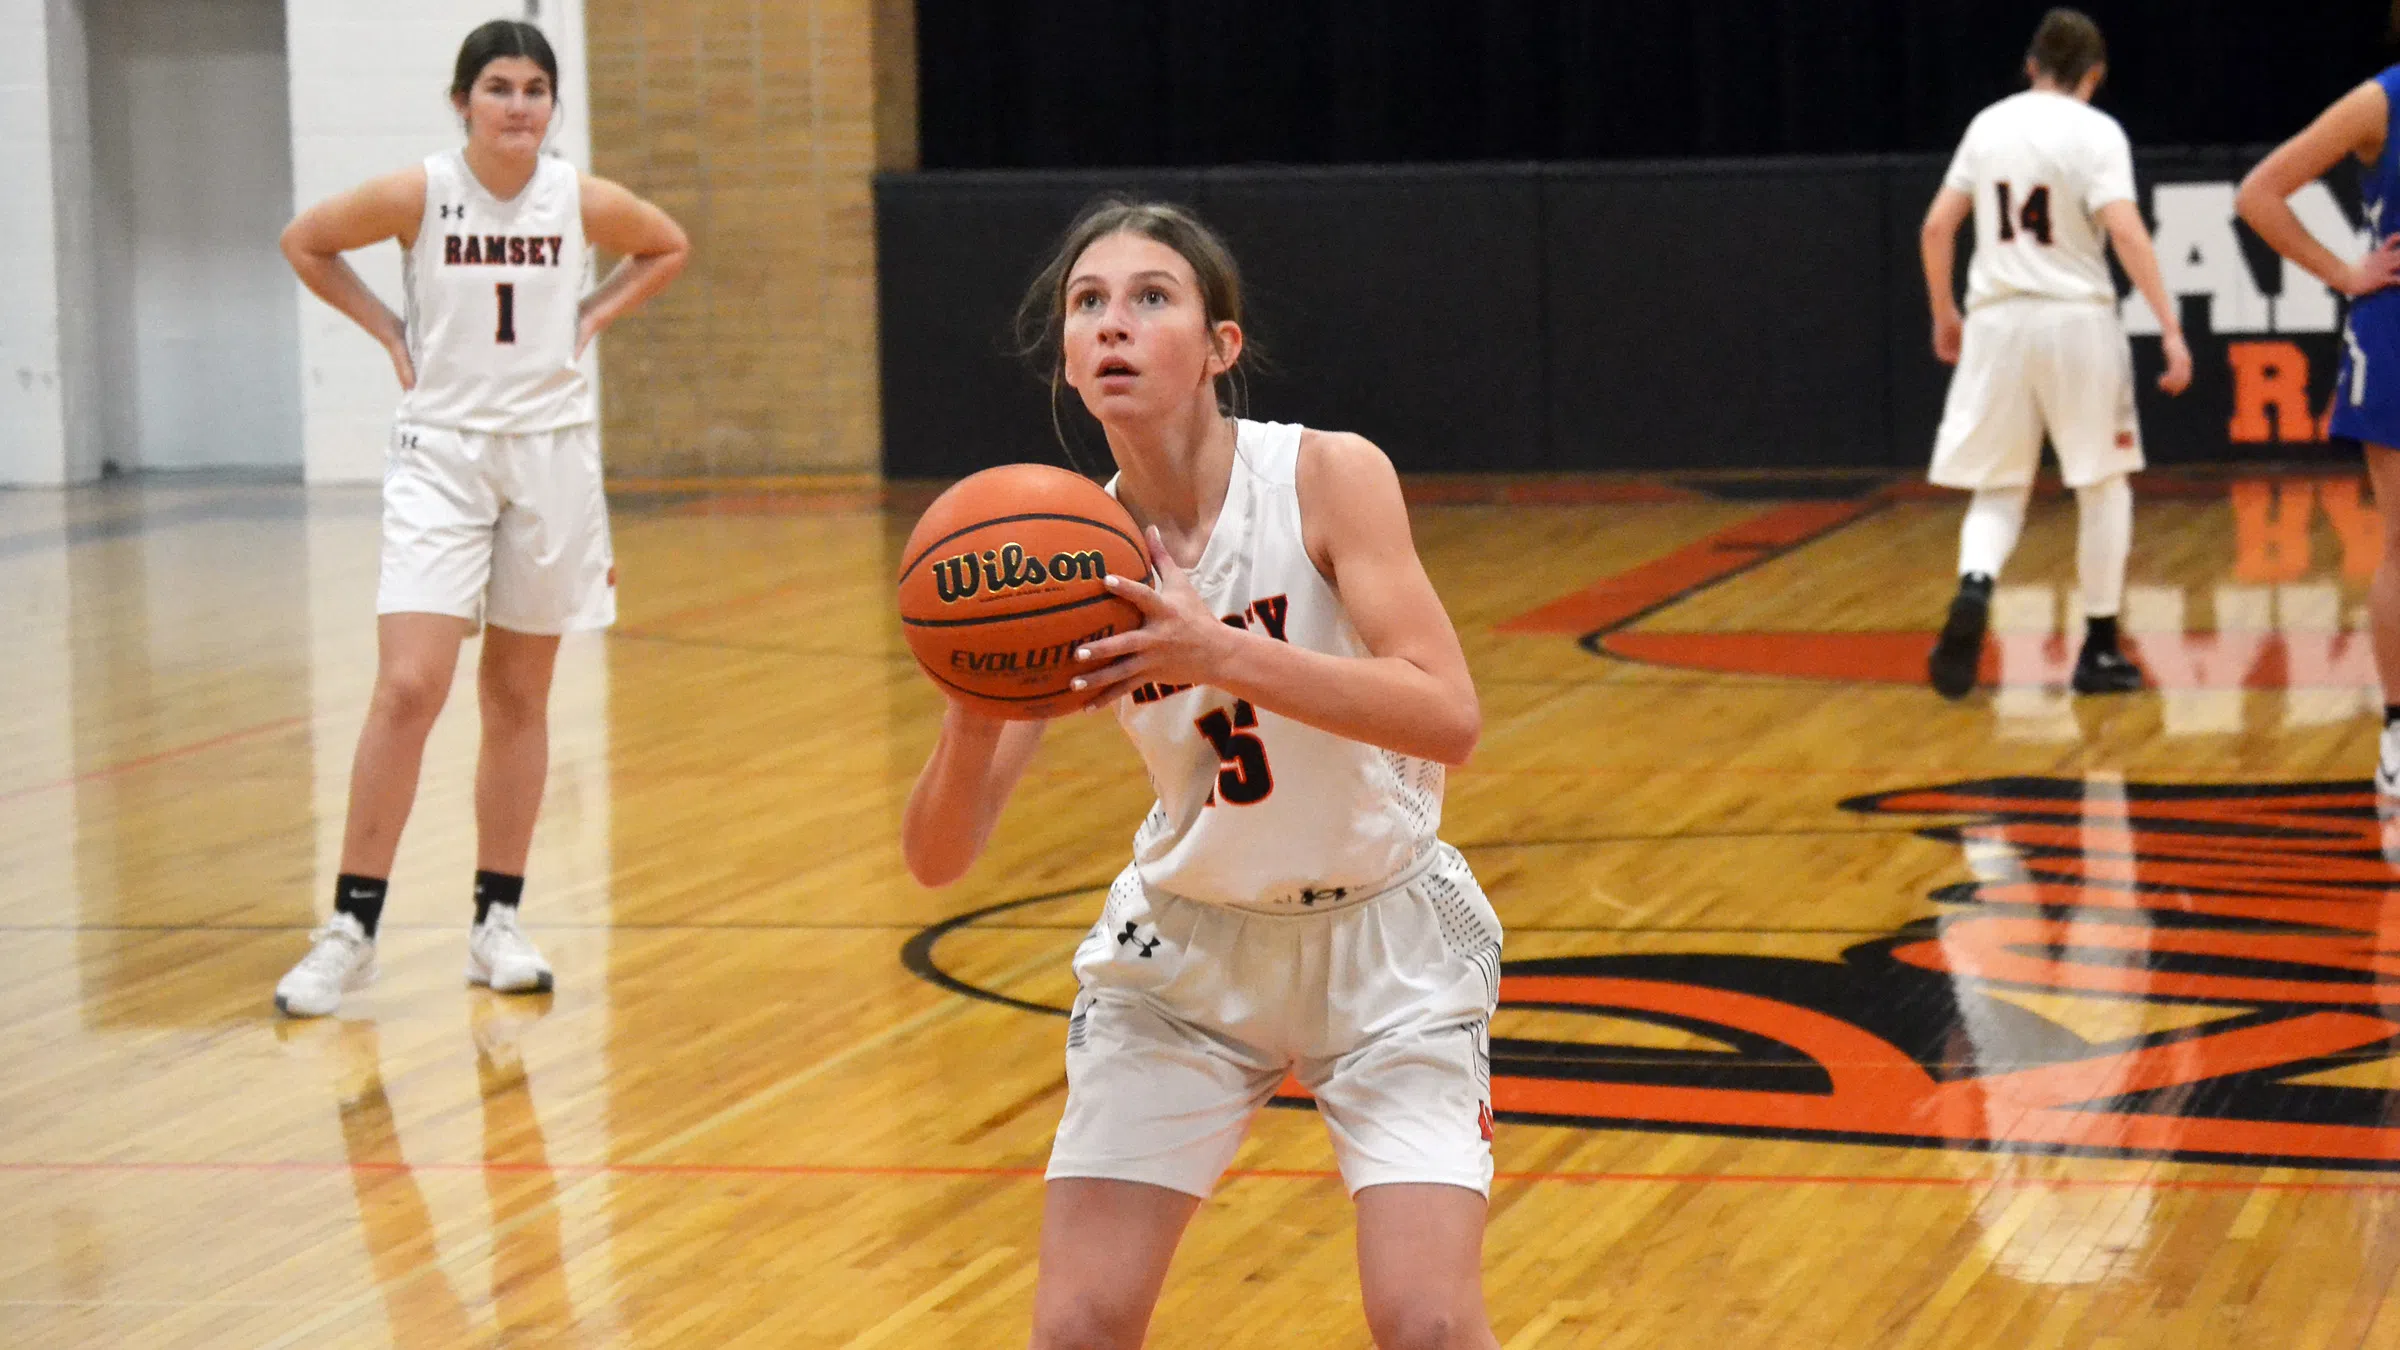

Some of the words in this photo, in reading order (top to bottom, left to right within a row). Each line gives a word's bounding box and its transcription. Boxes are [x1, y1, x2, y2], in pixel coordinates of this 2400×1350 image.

[1995, 181, 2053, 245] 14
[444, 235, 562, 266] RAMSEY
[495, 283, 515, 343] 1
[932, 542, 1106, 604] Wilson
[950, 624, 1115, 672] EVOLUTI
